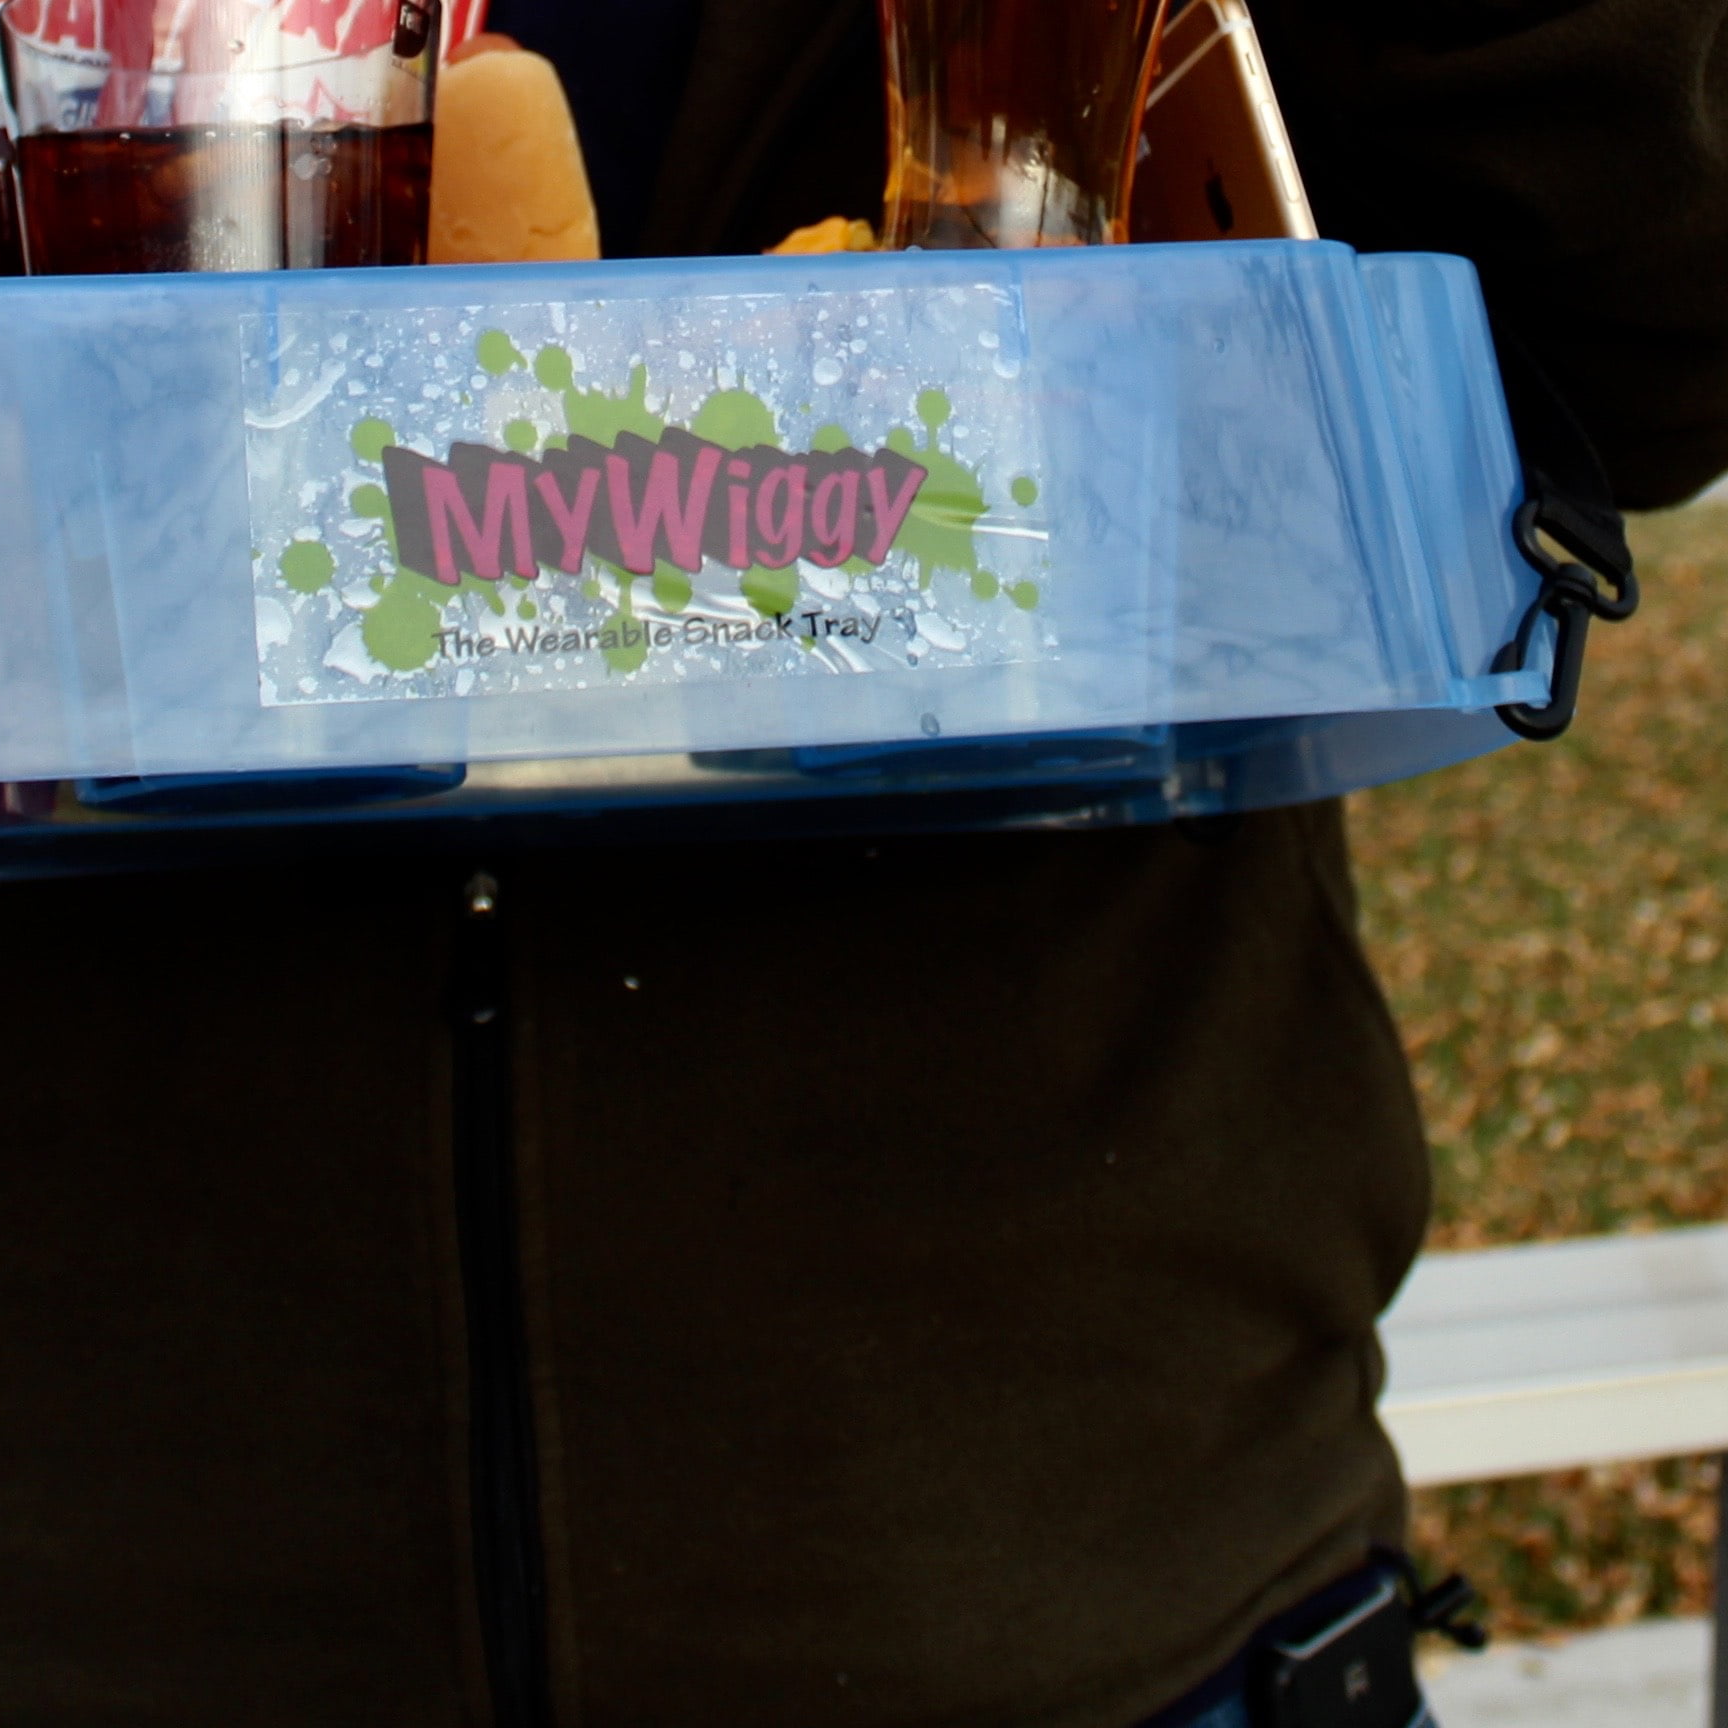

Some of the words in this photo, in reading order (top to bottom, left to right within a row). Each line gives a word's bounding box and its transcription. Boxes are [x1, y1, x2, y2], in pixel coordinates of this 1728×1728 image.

[431, 629, 497, 658] The
[505, 619, 672, 656] Wearable
[683, 611, 794, 645] Snack
[801, 609, 882, 645] Tray
